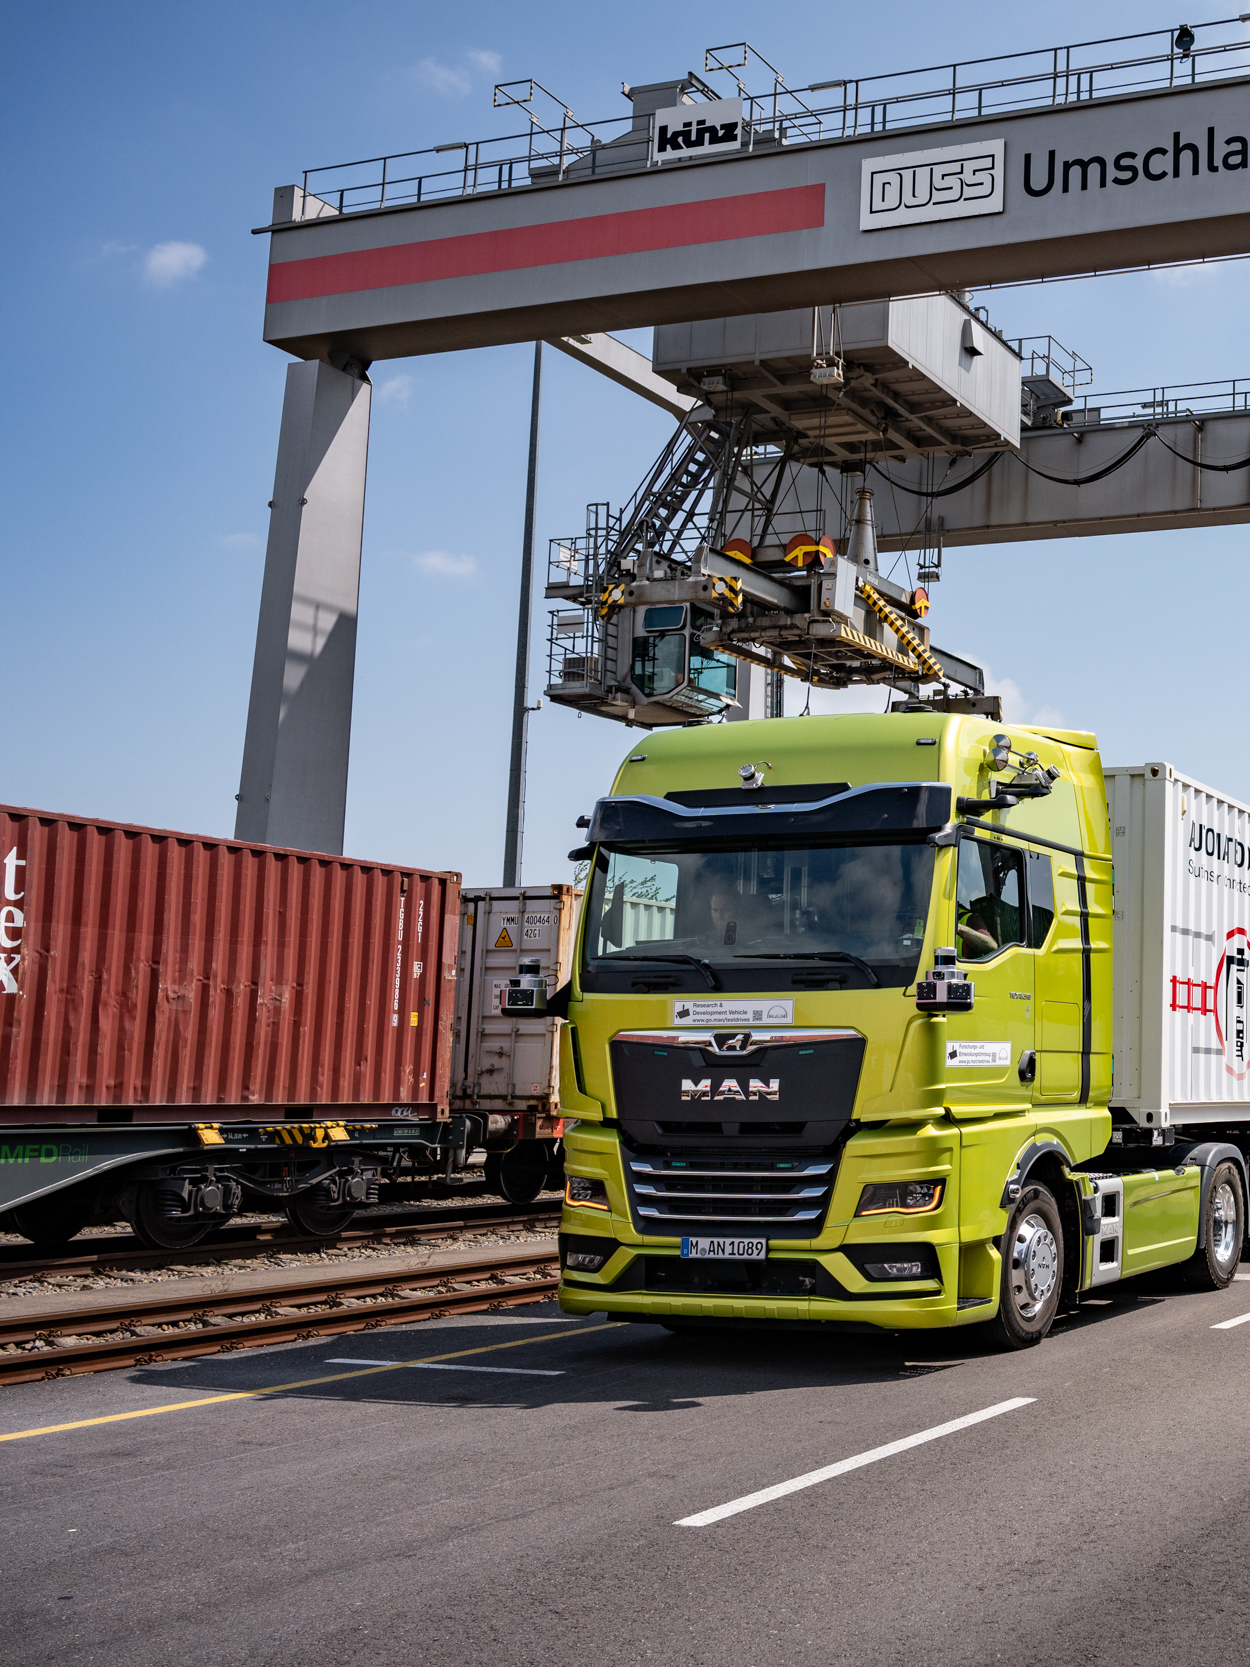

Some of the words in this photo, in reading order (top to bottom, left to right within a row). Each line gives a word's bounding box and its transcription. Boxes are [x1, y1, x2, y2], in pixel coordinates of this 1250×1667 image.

[658, 119, 738, 153] künz
[870, 154, 995, 214] DUSS
[502, 916, 518, 925] YMMU
[525, 916, 550, 924] 400464
[554, 916, 558, 924] 0
[525, 929, 540, 938] 42G1
[394, 945, 402, 1010] 233986
[681, 1079, 780, 1100] MAN
[1101, 1223, 1119, 1236] MAN
[690, 1240, 699, 1255] M
